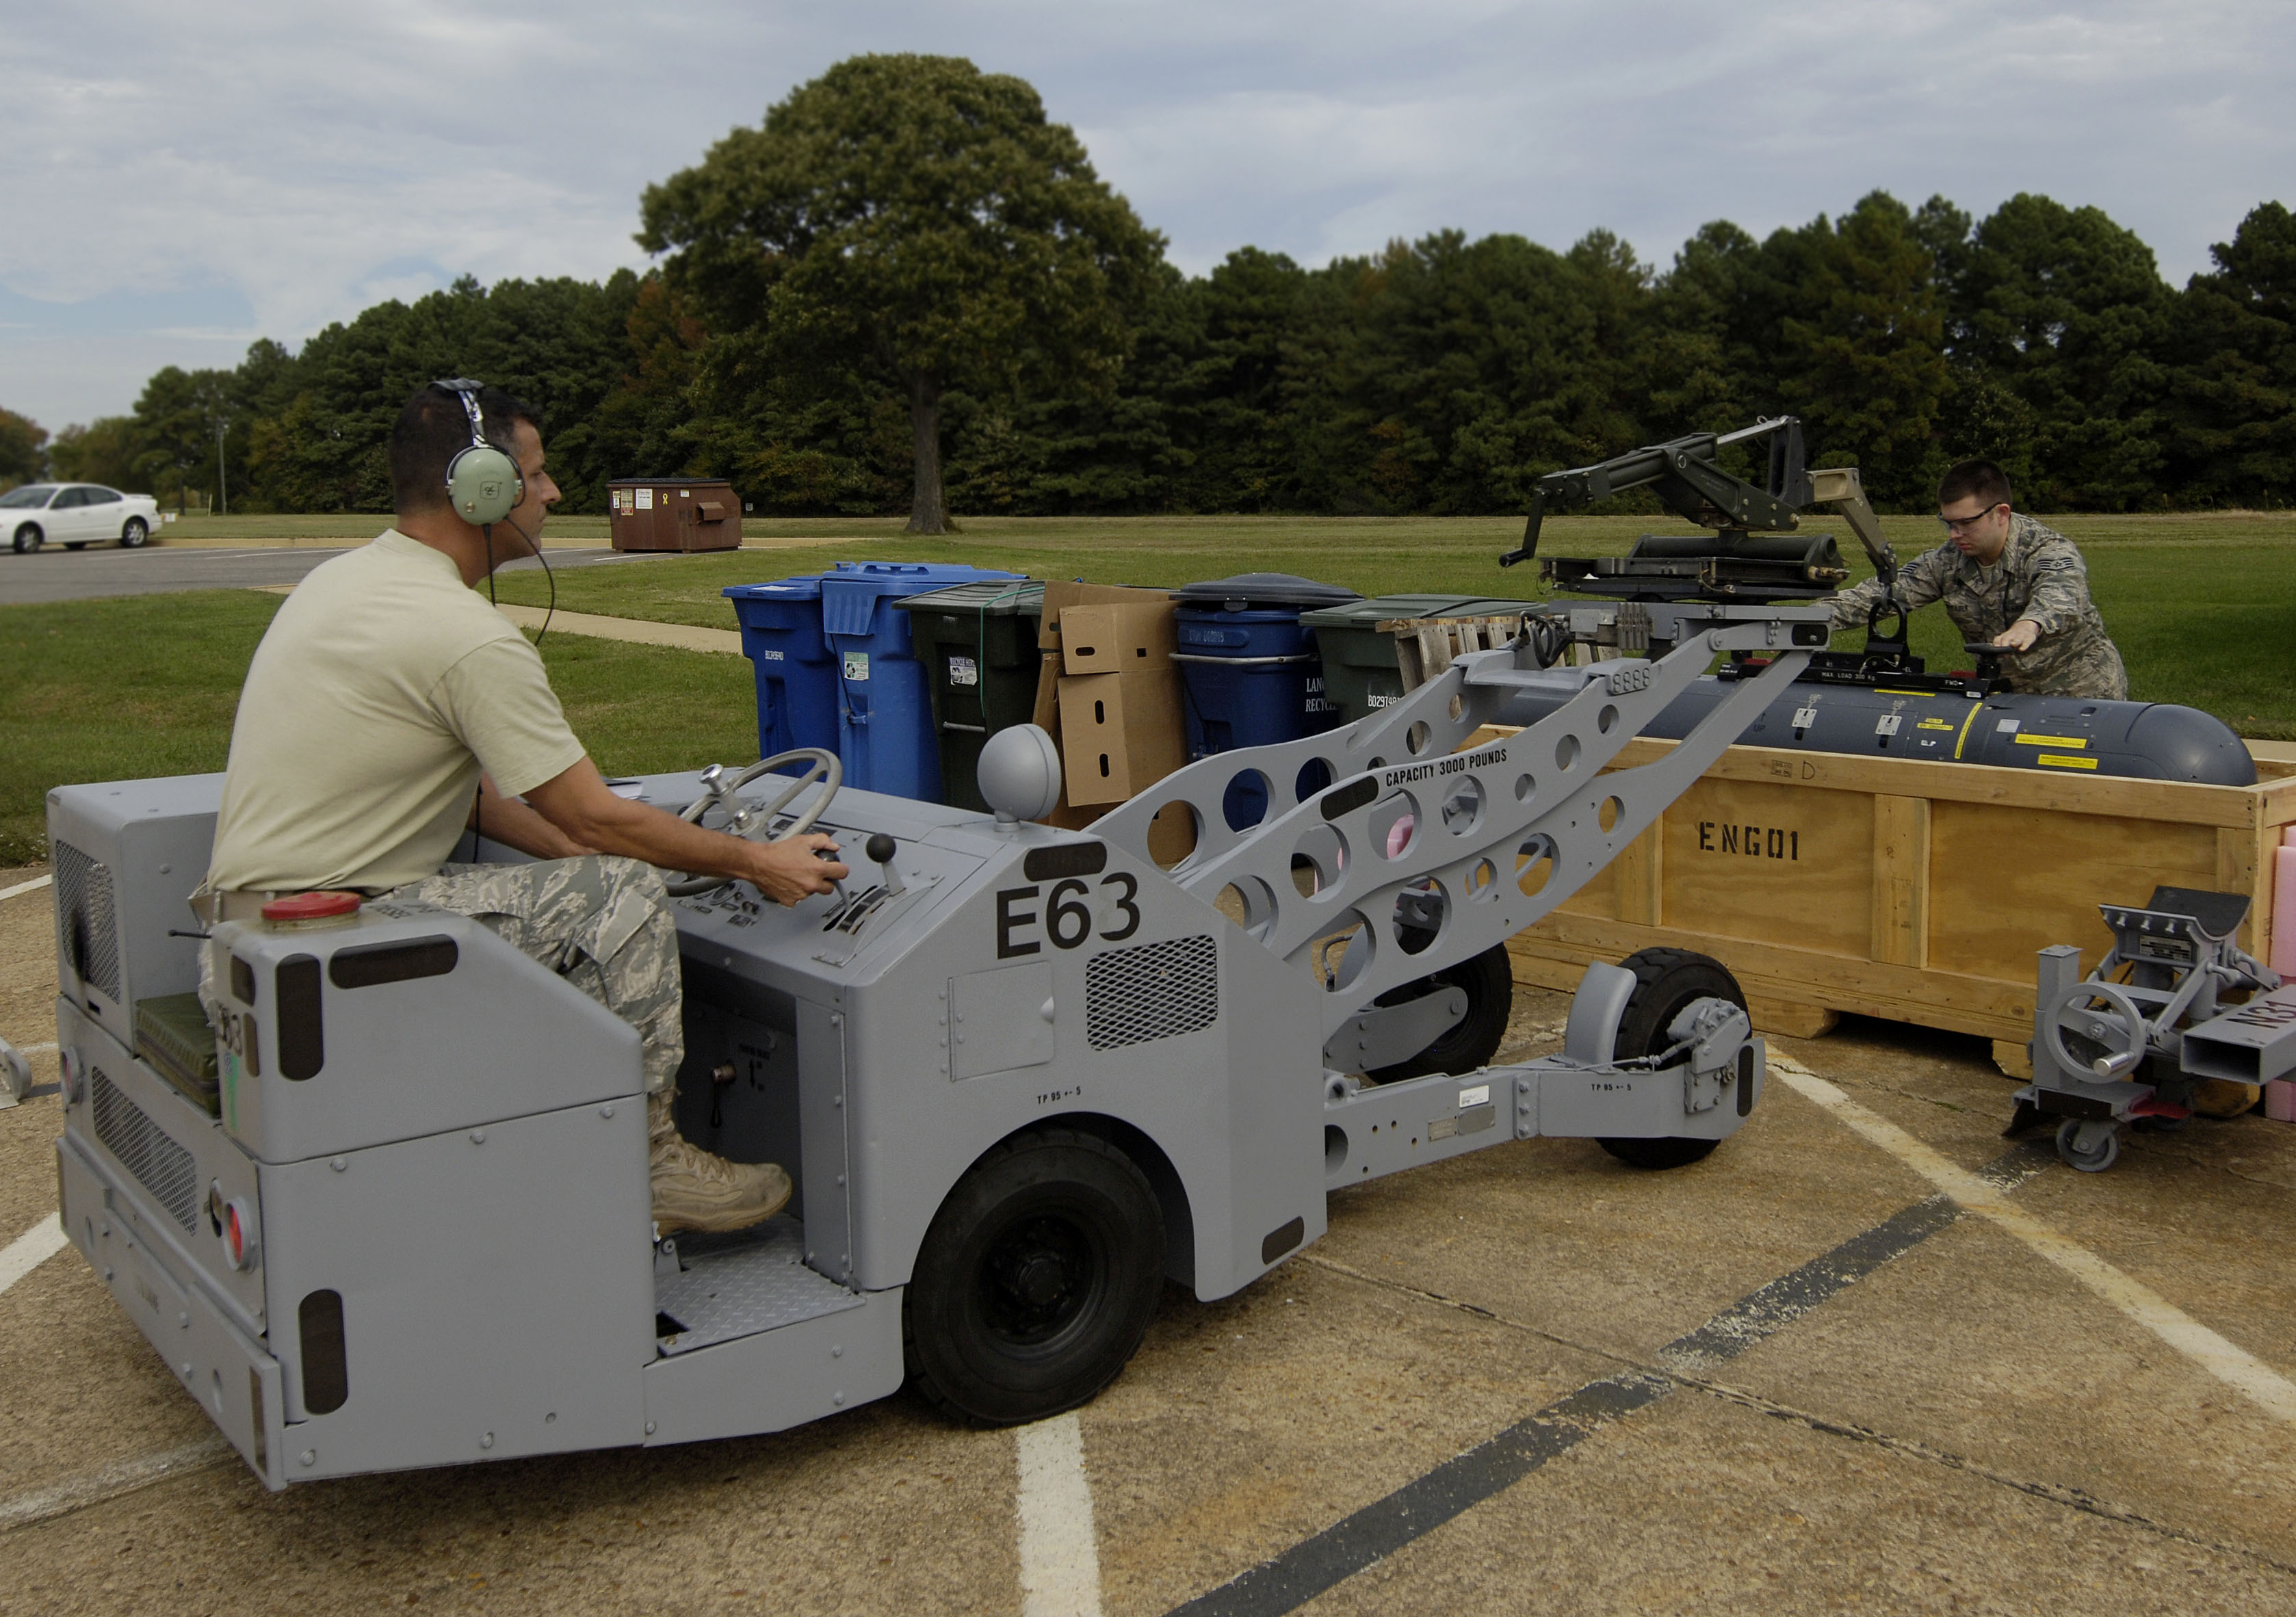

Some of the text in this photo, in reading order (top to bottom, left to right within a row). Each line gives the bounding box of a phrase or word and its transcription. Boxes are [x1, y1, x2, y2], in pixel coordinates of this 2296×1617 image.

[1307, 677, 1325, 692] LAN
[1386, 748, 1507, 787] CAPACITY 3000 POUNDS
[996, 872, 1140, 960] E63
[1037, 1094, 1047, 1104] TP
[1051, 1091, 1060, 1101] 95
[1076, 1086, 1081, 1095] 5
